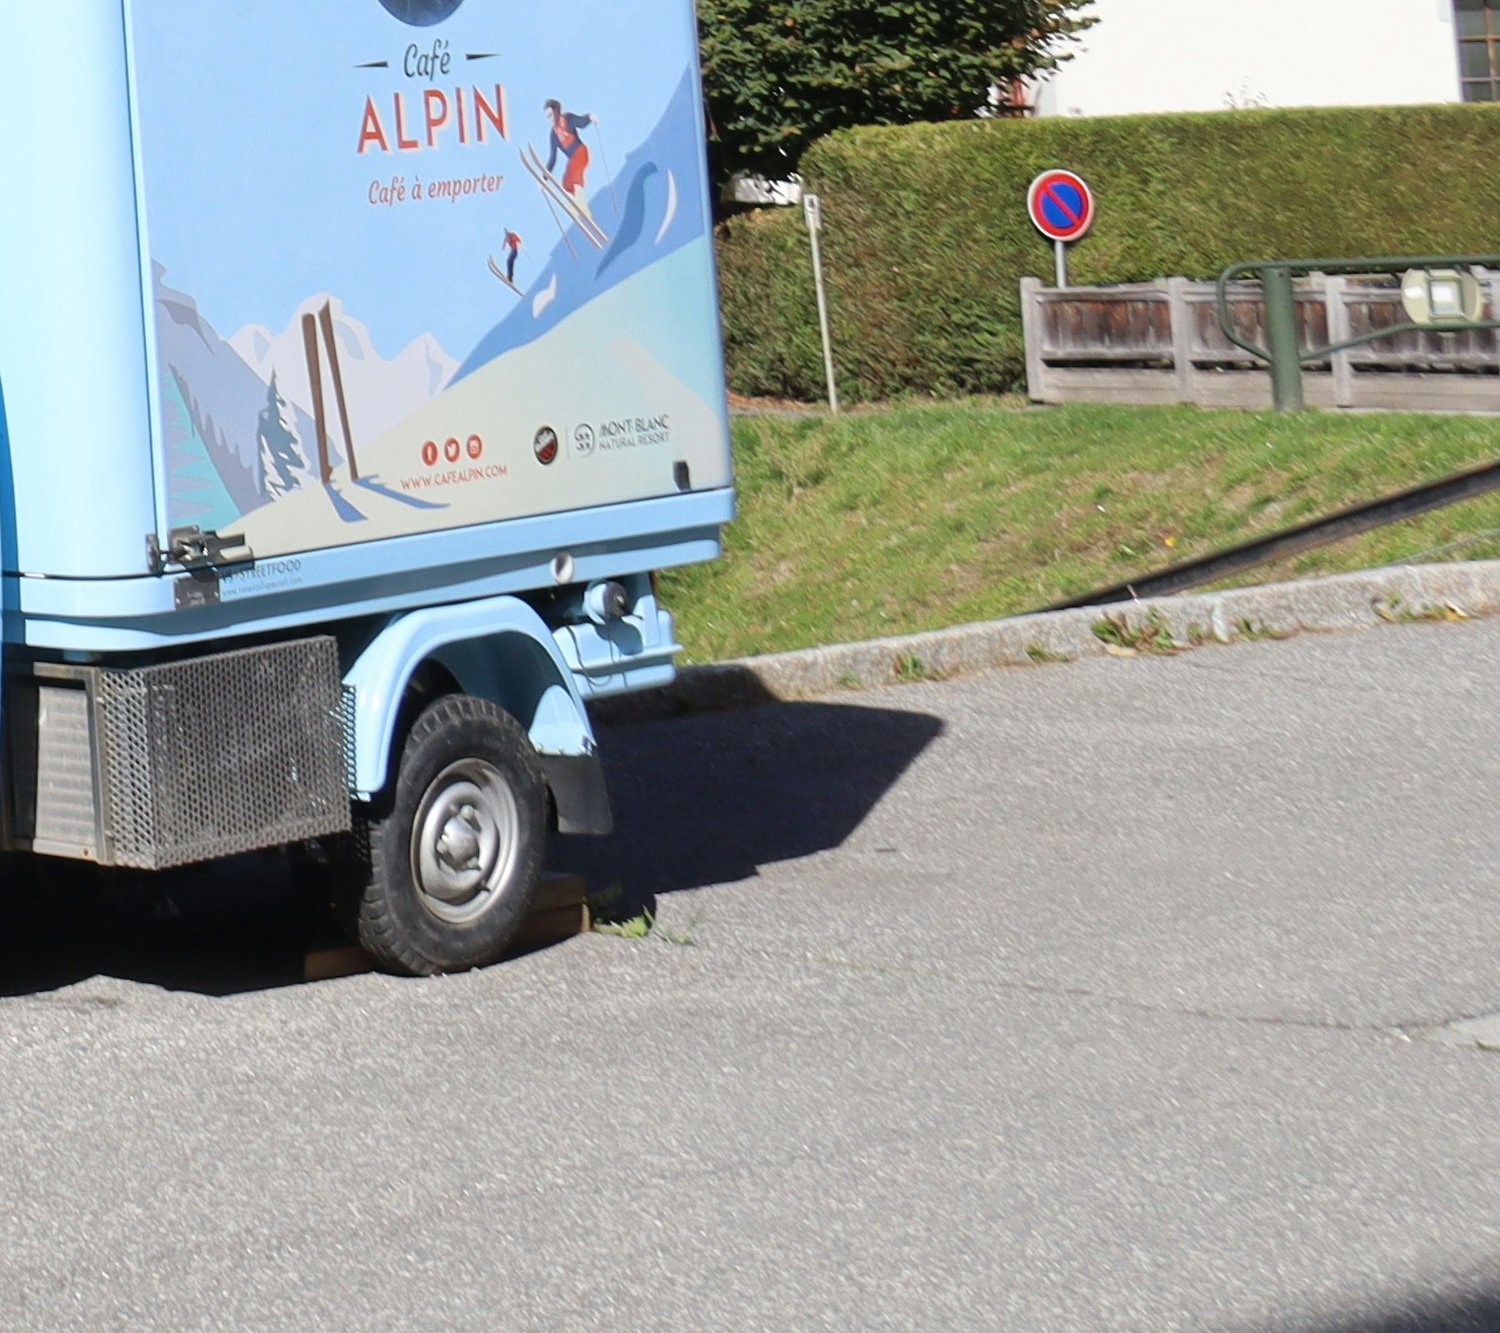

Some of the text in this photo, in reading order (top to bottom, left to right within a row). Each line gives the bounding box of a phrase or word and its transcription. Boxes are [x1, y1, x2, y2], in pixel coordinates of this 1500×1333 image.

[404, 38, 451, 81] Café
[357, 83, 507, 154] ALPIN
[369, 173, 504, 206] Café à emporter
[599, 436, 637, 451] NATURAL
[400, 464, 508, 491] WWW.CAFEALPIN.COM
